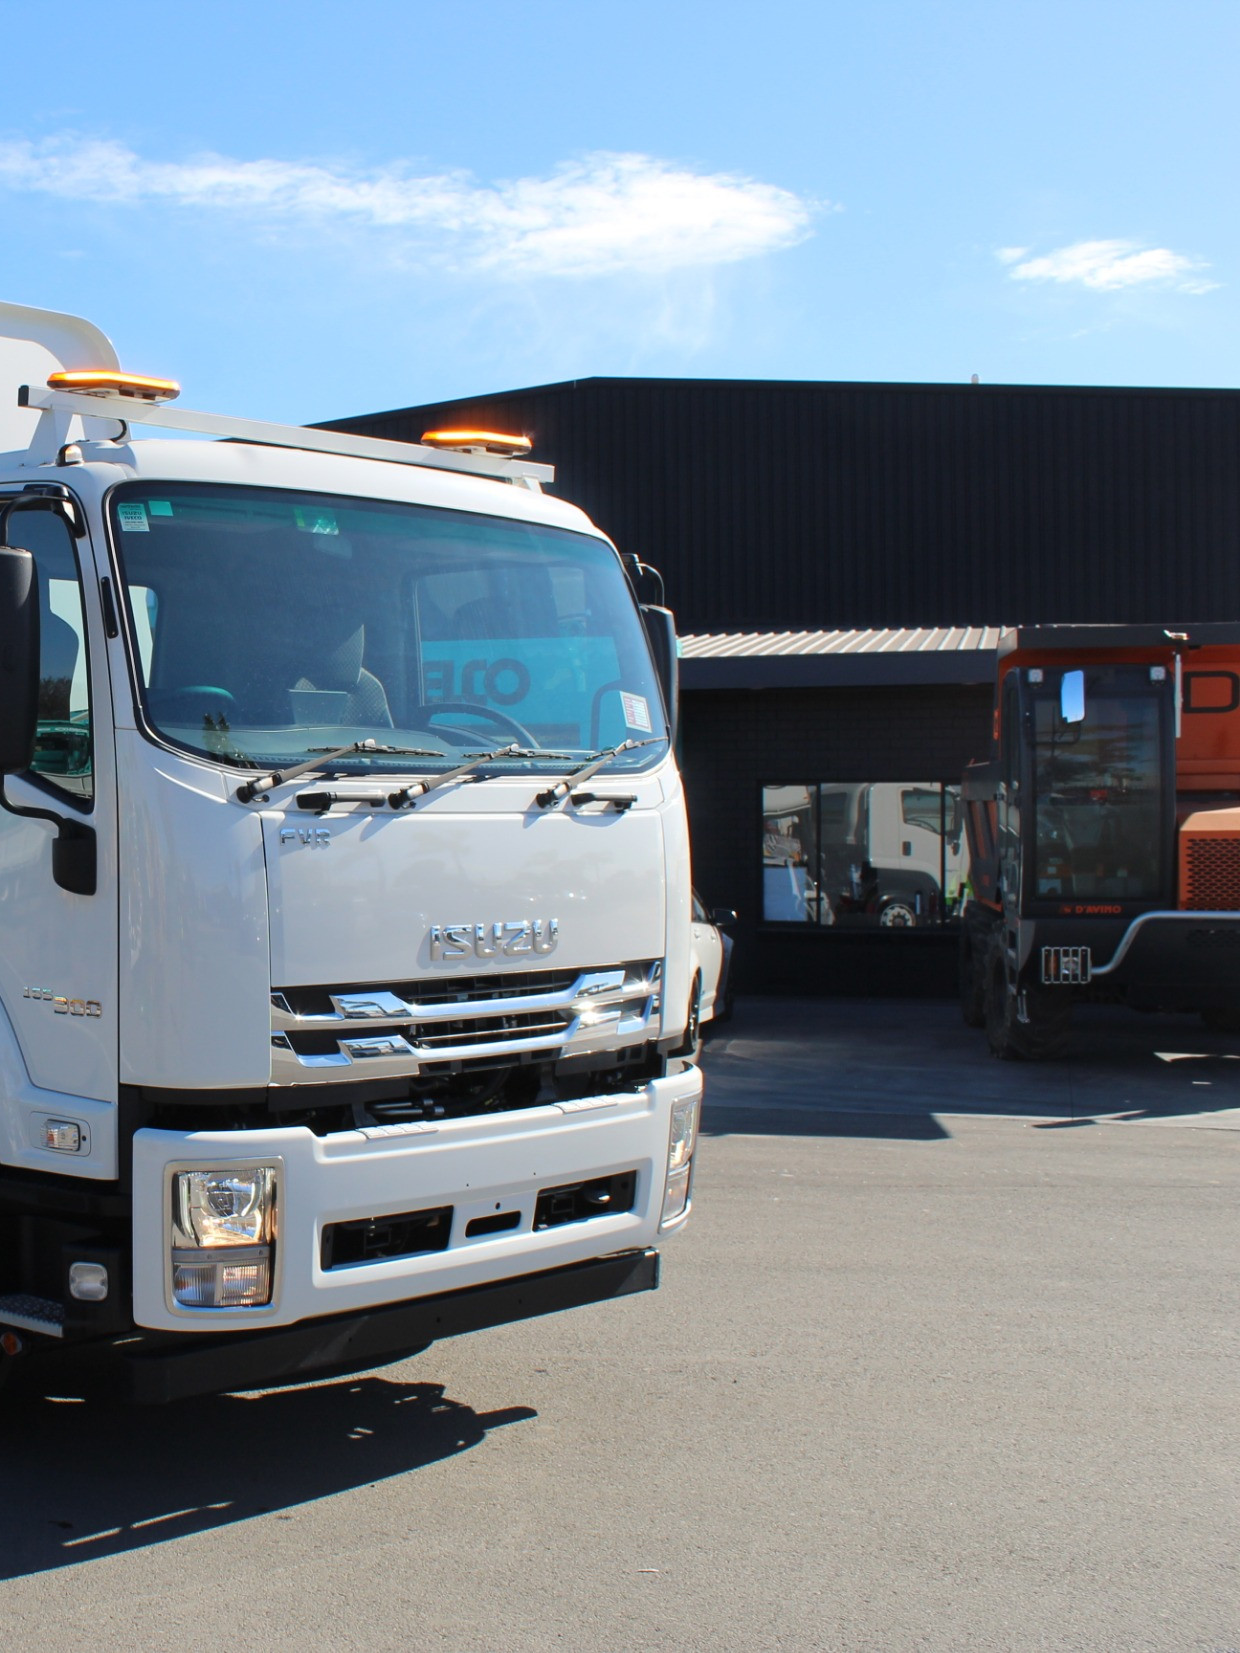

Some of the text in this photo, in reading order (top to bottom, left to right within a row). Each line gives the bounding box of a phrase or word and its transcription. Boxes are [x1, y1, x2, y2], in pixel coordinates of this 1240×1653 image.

[423, 658, 531, 707] ELCO
[279, 827, 331, 846] FVR
[429, 917, 559, 961] ISUZU
[53, 995, 102, 1018] 300
